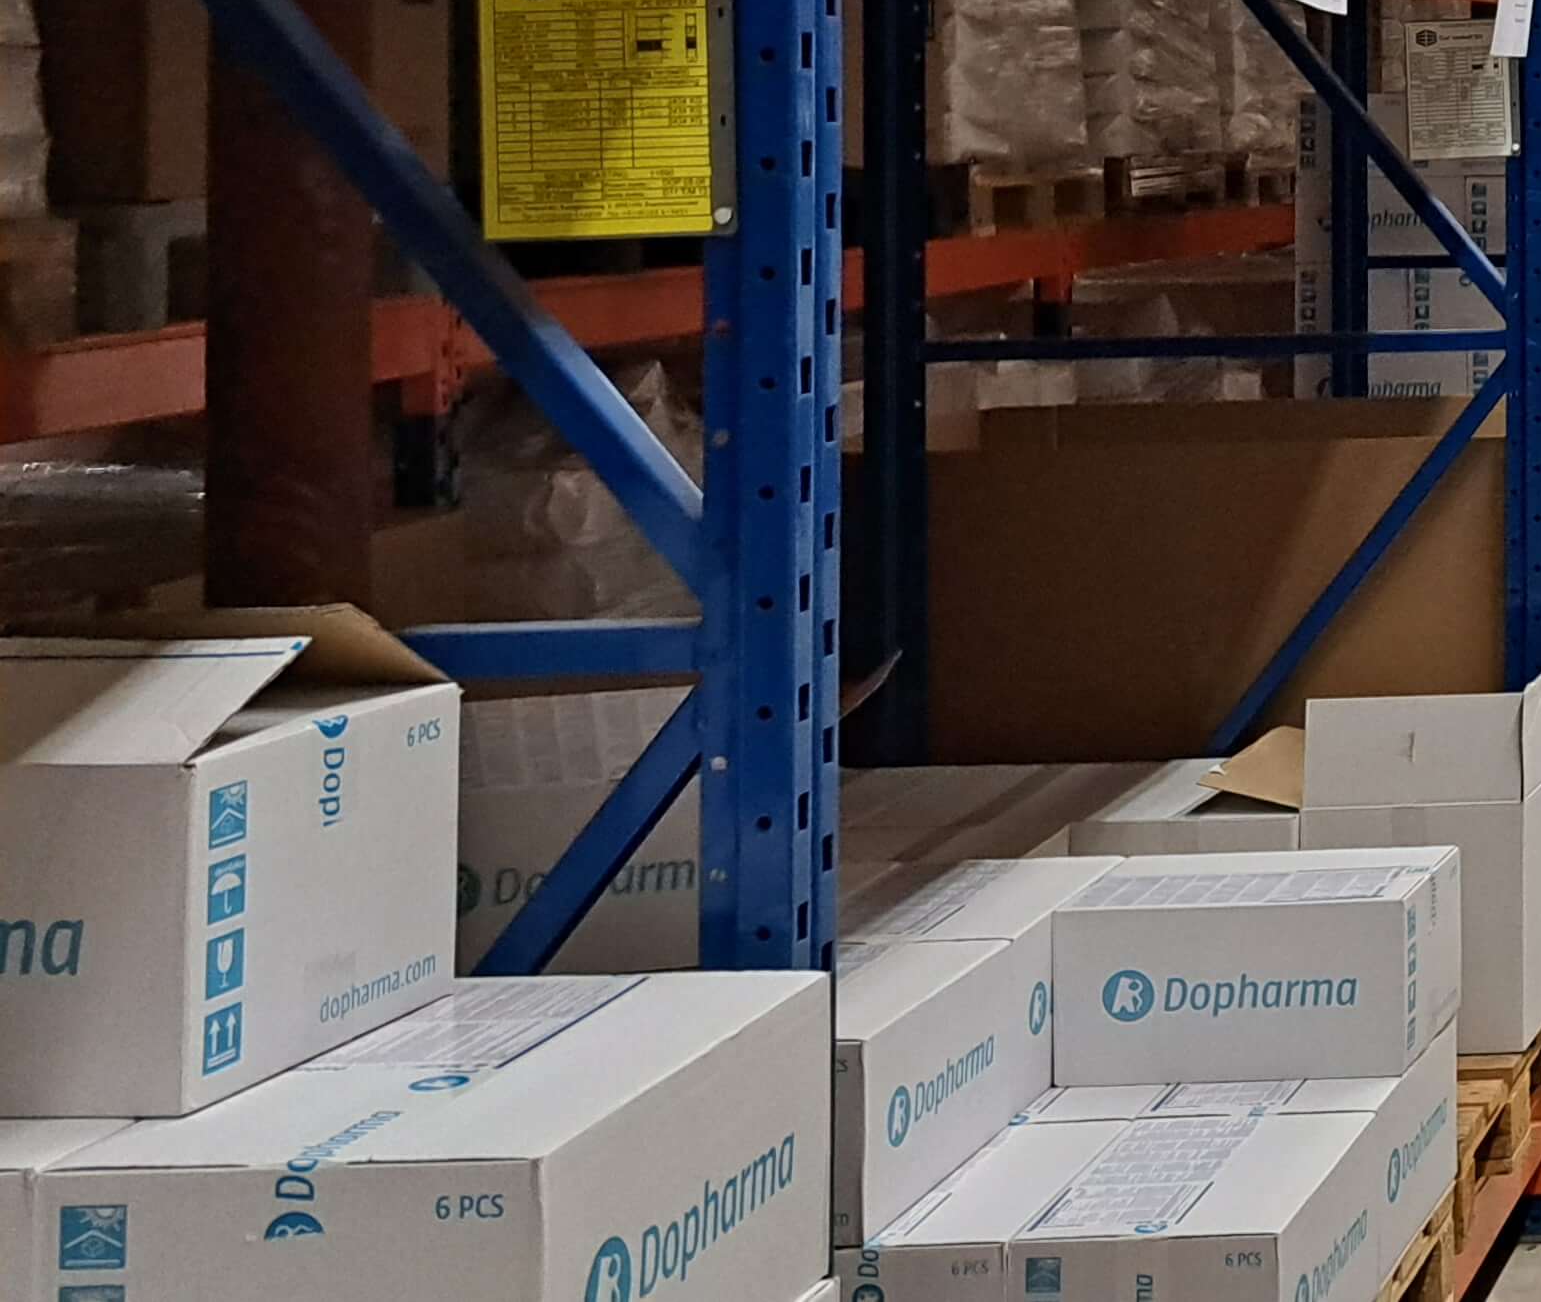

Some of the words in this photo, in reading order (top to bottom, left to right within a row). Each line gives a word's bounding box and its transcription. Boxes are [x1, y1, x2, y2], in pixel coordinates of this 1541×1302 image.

[406, 726, 416, 747] 6
[418, 717, 442, 742] PCS
[320, 953, 437, 1024] dopharma.com
[1163, 972, 1358, 1012] Dopharma
[913, 1033, 996, 1128] Dopharma
[1400, 1096, 1449, 1180] Dopharma
[435, 1195, 450, 1220] 6
[458, 1194, 505, 1219] PCS
[639, 1131, 796, 1297] Dopharma
[950, 1261, 960, 1276] 6
[962, 1259, 990, 1276] PCS
[1224, 1253, 1234, 1268] 6
[1236, 1251, 1263, 1268] PCS
[1307, 1207, 1369, 1302] Dopharma
